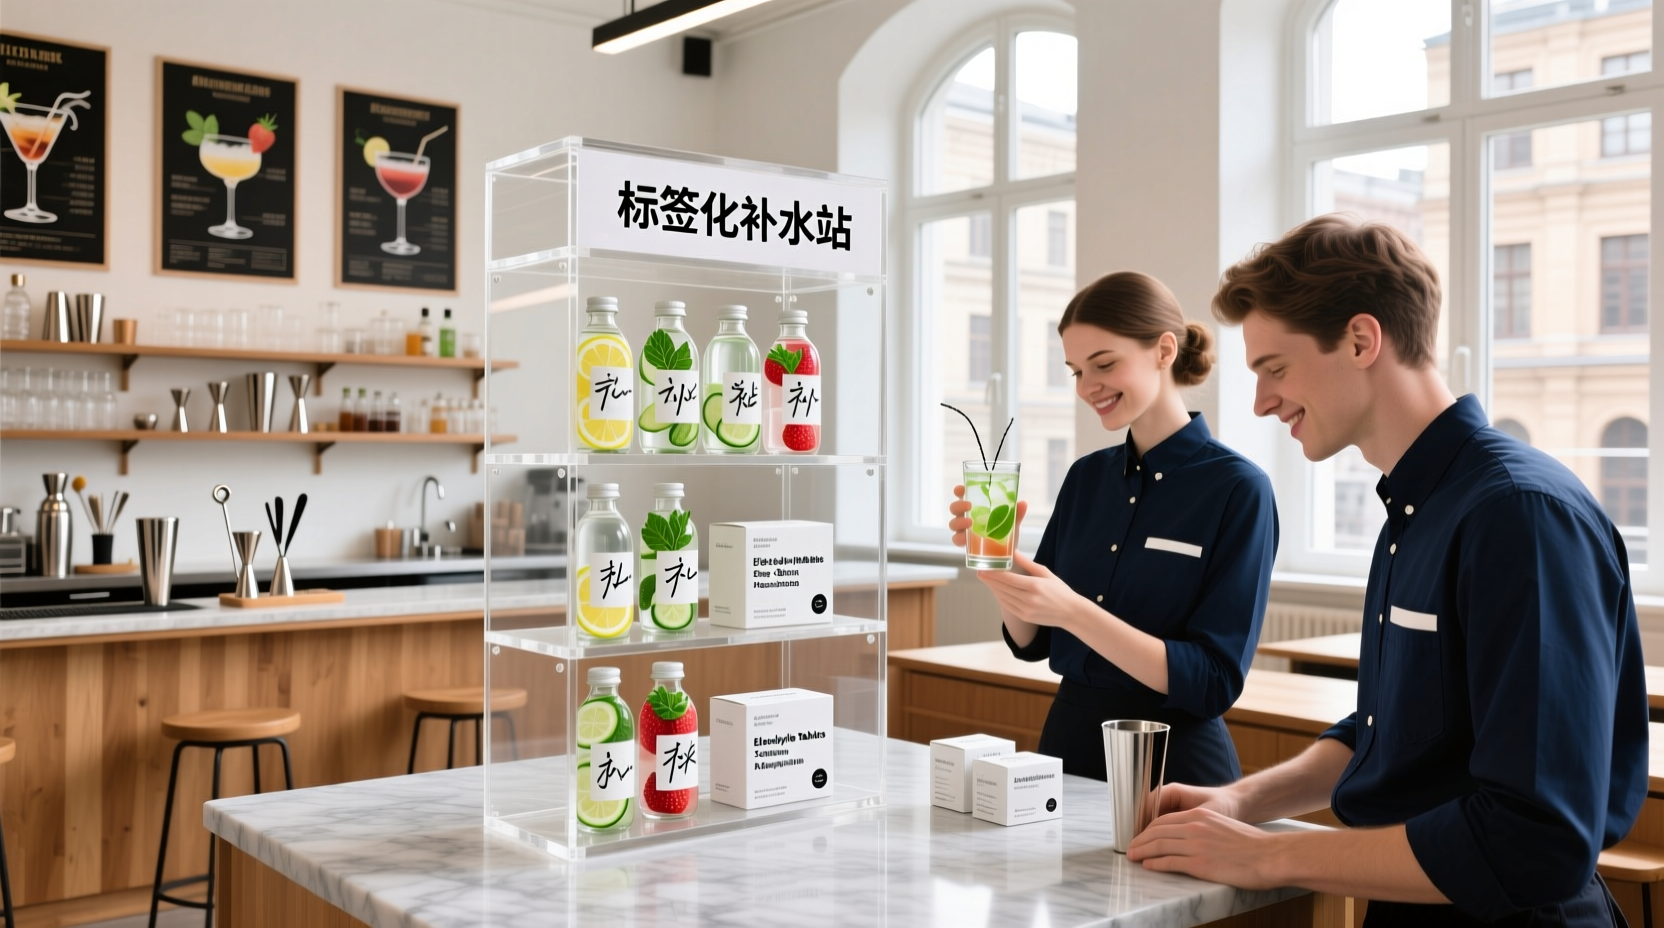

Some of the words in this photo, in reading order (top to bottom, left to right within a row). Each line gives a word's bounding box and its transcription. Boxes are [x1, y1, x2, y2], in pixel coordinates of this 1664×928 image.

[617, 180, 853, 251] 标签化补水站
